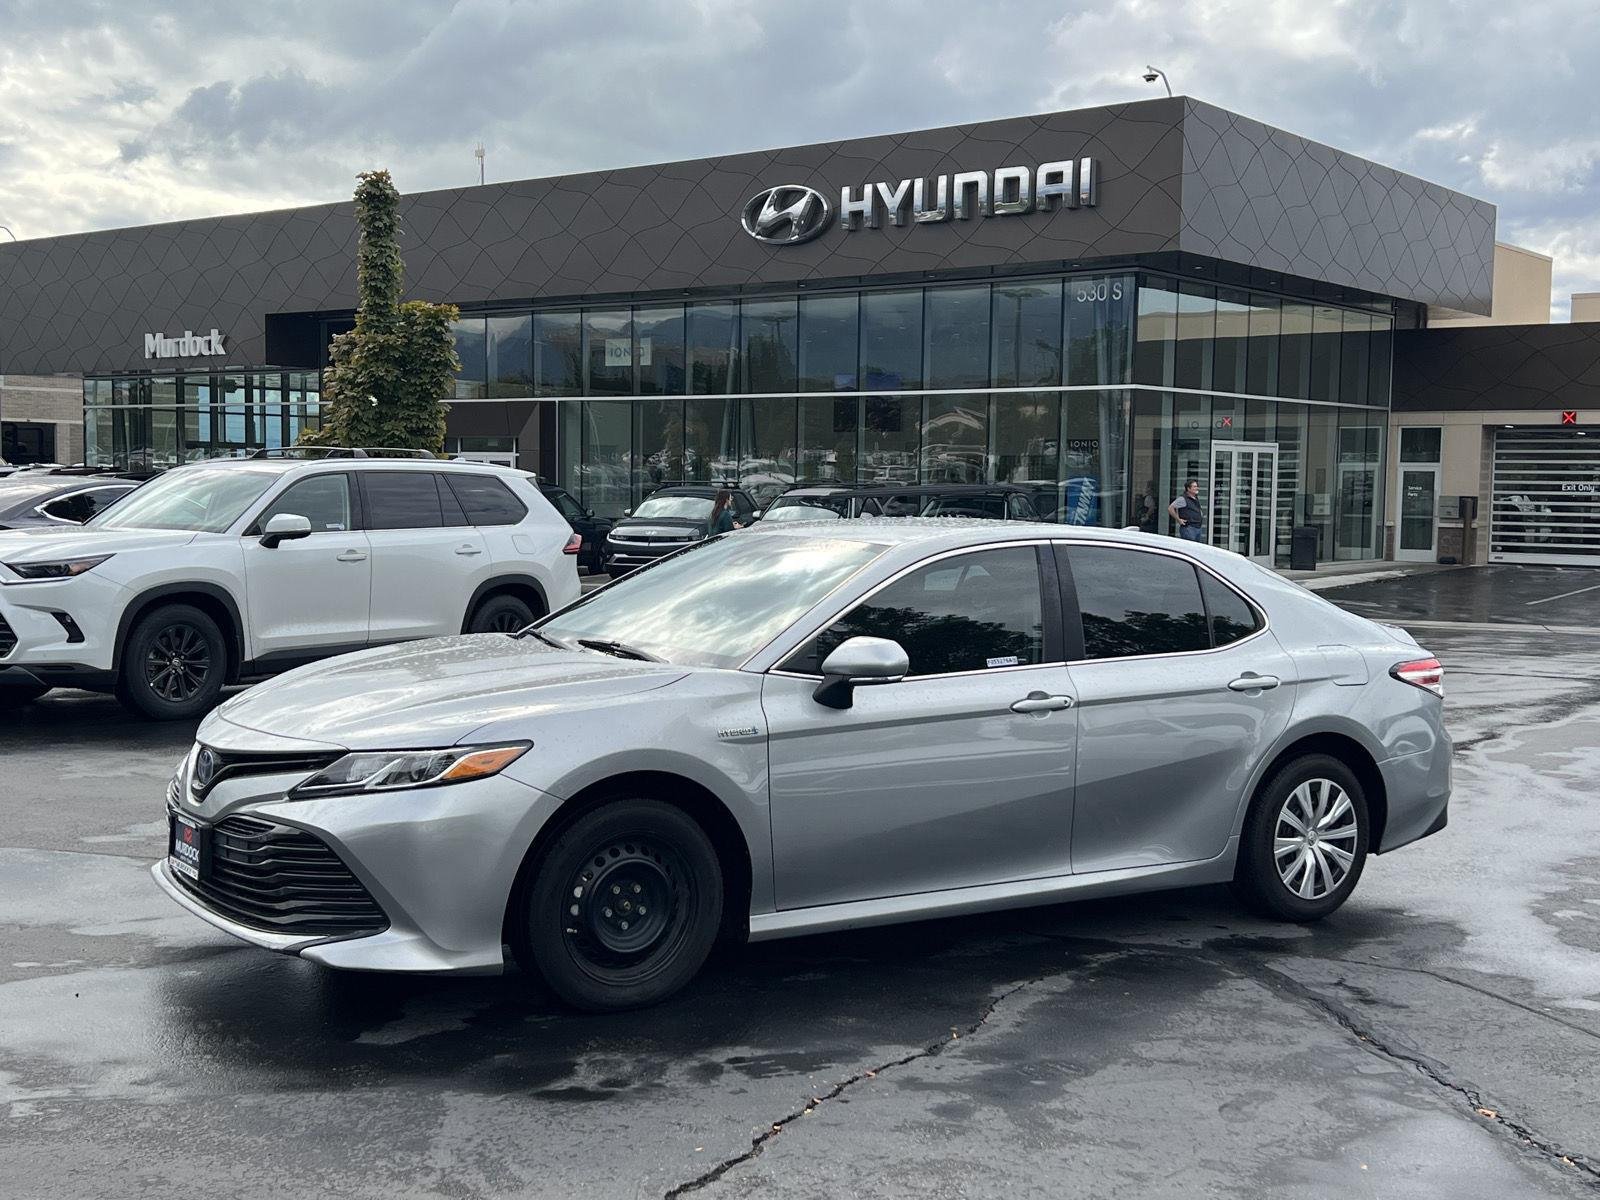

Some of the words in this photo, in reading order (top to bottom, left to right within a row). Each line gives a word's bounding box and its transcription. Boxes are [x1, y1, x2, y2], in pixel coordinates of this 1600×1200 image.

[841, 157, 1096, 230] HYUNDAI
[1077, 283, 1107, 302] 530
[1112, 282, 1122, 300] S
[144, 328, 226, 359] Murdock
[1562, 483, 1577, 491] Exit
[1578, 483, 1595, 493] Only
[175, 839, 200, 862] MURDOCK
